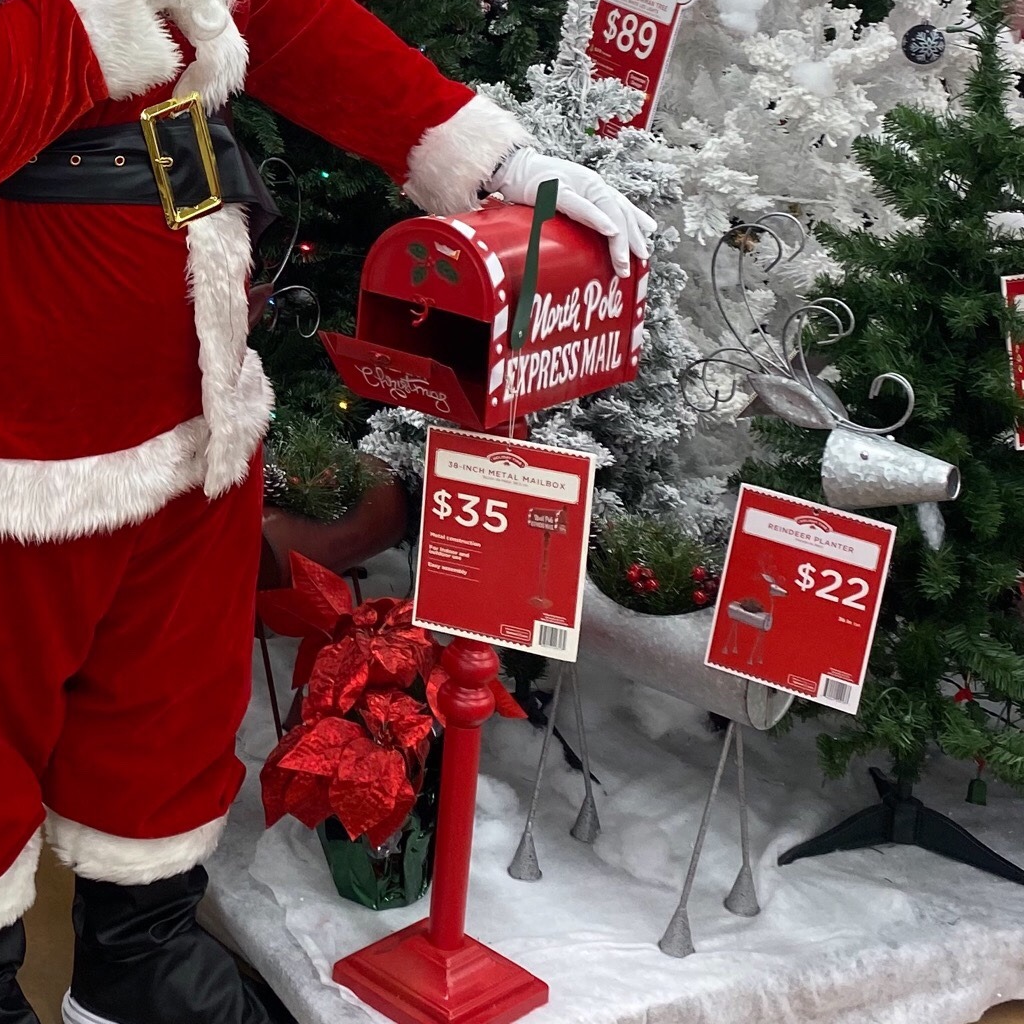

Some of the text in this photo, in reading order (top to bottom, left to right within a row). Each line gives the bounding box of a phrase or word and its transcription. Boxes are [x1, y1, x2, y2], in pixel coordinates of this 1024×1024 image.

[603, 8, 658, 60] $89
[529, 275, 623, 344] North Pole
[502, 329, 622, 404] EXPRESS MAIL
[447, 460, 486, 475] 38-INCH
[487, 469, 518, 481] METAL
[522, 475, 566, 491] MAILBOX
[431, 488, 509, 534] $35
[767, 522, 812, 541] REINDEER
[813, 536, 855, 554] PLANTER
[794, 562, 870, 612] $22
